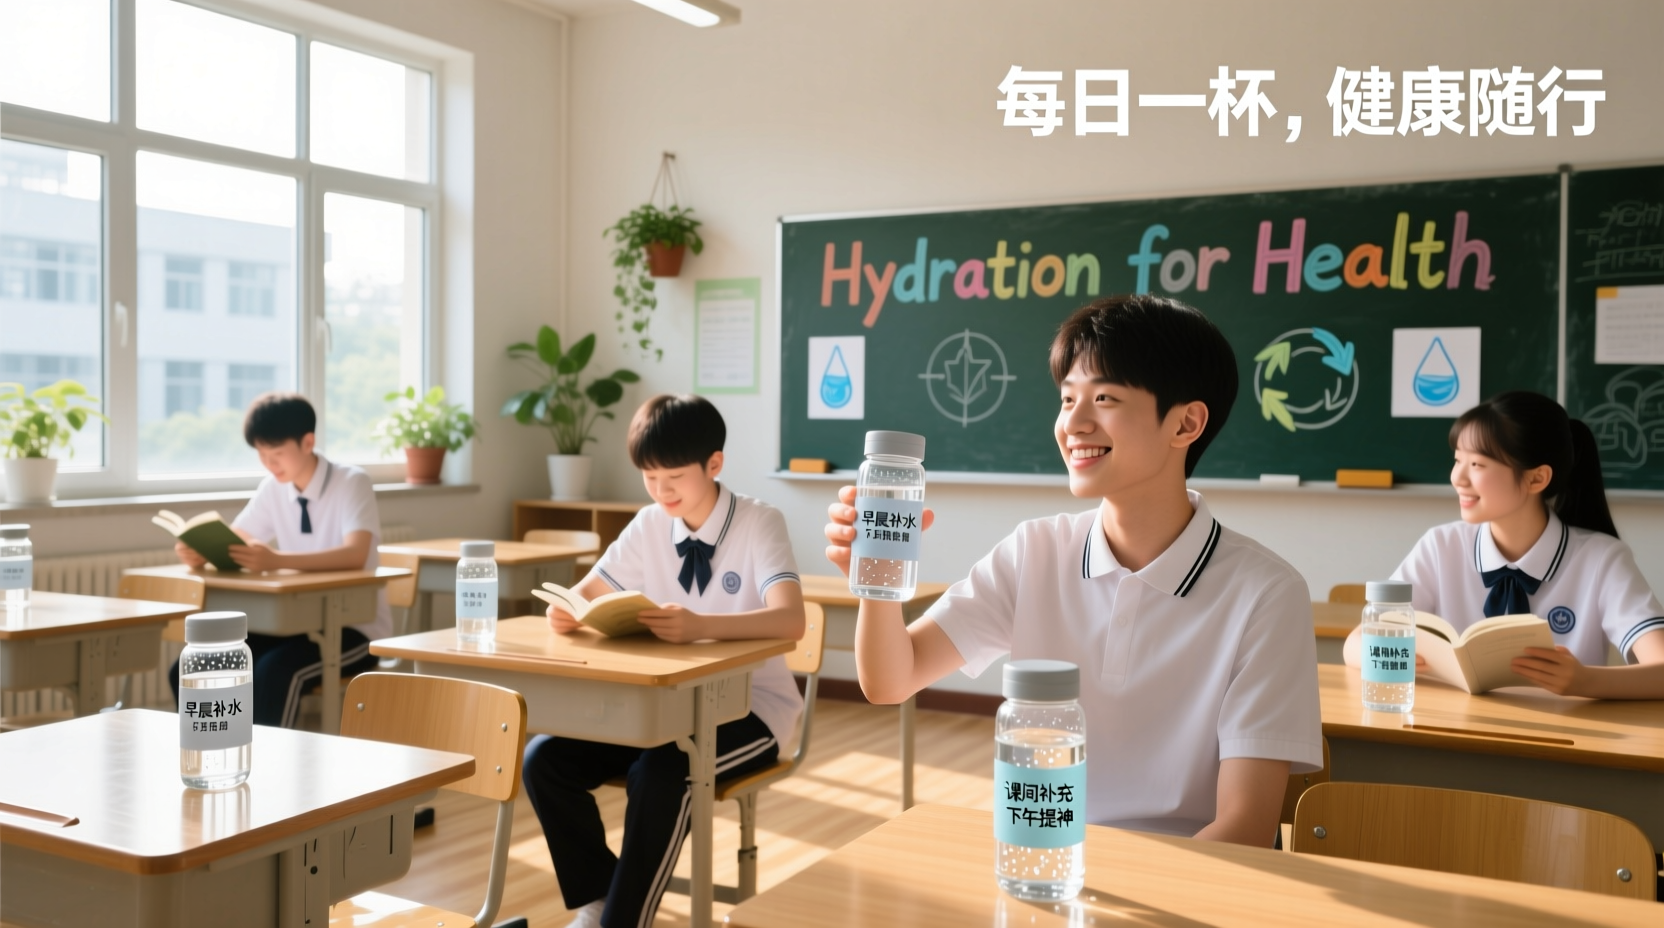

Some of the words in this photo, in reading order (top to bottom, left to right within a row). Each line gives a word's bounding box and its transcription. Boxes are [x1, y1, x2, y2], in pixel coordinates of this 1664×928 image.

[820, 237, 1100, 328] Hydration
[1127, 224, 1230, 296] for
[1252, 211, 1495, 293] Health
[1004, 781, 1075, 803] 课间补充
[1006, 806, 1074, 828] 下午提神
